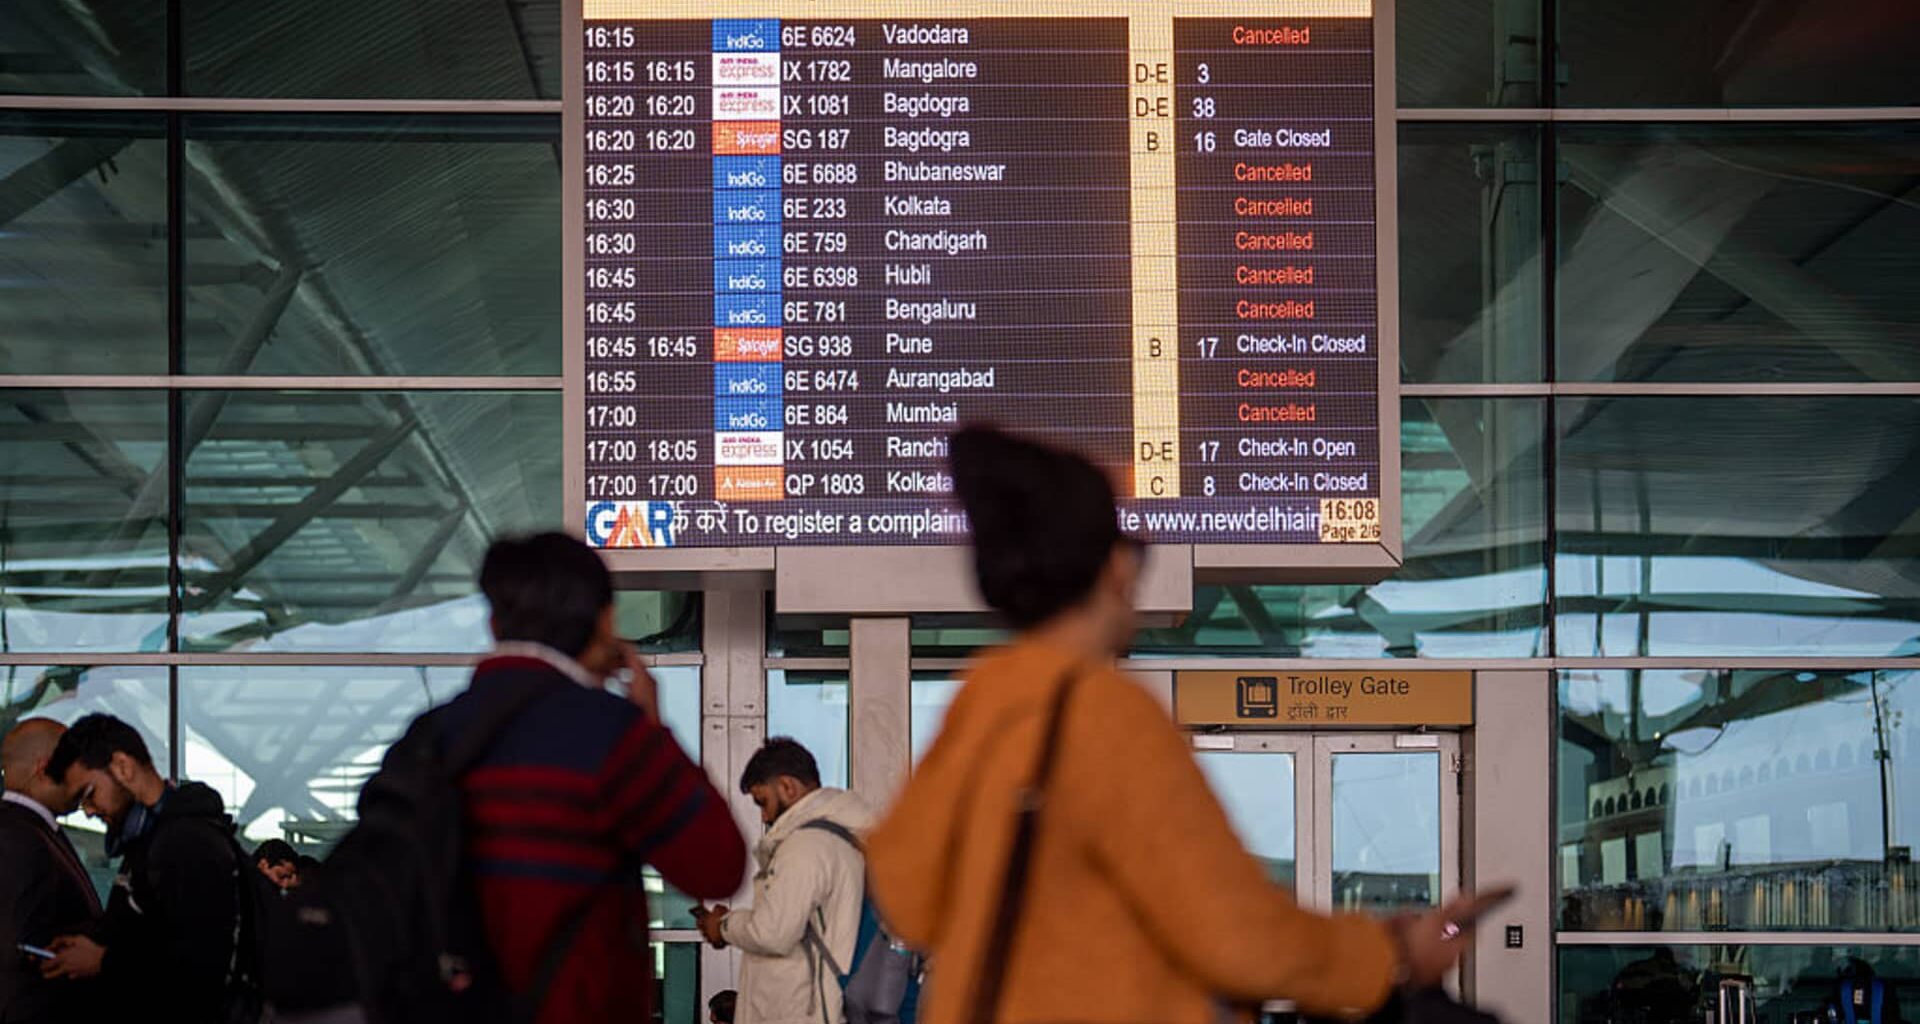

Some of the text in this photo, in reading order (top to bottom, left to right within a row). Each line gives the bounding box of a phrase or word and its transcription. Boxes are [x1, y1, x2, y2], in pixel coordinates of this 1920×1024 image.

[586, 27, 634, 47] 16:15
[782, 27, 806, 46] 6E
[812, 26, 855, 46] 6624
[883, 24, 968, 44] Vadodara
[1232, 26, 1309, 44] Cancelled
[586, 62, 634, 81] 16:15
[647, 61, 694, 81] 16:15
[784, 61, 801, 81] IX
[808, 61, 850, 81] 1782
[884, 58, 976, 83] Mangalore
[1136, 64, 1168, 83] D-E
[1198, 64, 1209, 83] 3
[586, 96, 634, 116] 16:20
[647, 96, 694, 116] 16:20
[784, 95, 801, 115] IX
[808, 95, 848, 115] 1081
[884, 93, 969, 117] Bagdogra
[1136, 98, 1168, 117] D-E
[1193, 98, 1215, 117] 38
[587, 130, 634, 150] 16:20
[647, 130, 694, 150] 16:20
[784, 129, 811, 149] SG
[818, 129, 850, 149] 187
[885, 127, 969, 152] Bagdogra
[1147, 132, 1159, 151] B
[1194, 132, 1215, 152] 16
[1234, 129, 1271, 146] Gate
[1276, 129, 1330, 146] Closed
[587, 165, 634, 185] 16:25
[784, 164, 807, 183] 6E
[813, 164, 857, 183] 6688
[885, 161, 1005, 181] Bhubaneswar
[1235, 162, 1311, 181] Cancelled
[587, 199, 634, 220] 16:30
[784, 199, 808, 218] 6E
[813, 198, 846, 218] 233
[885, 196, 951, 215] Kolkata
[1235, 197, 1312, 215] Cancelled
[587, 233, 635, 254] 16:30
[784, 233, 808, 252] 6E
[814, 233, 846, 252] 759
[885, 230, 986, 255] Chandigarh
[1235, 232, 1313, 250] Cancelled
[587, 268, 635, 288] 16:45
[784, 267, 808, 287] 6E
[814, 267, 857, 287] 6398
[886, 264, 930, 284] Hubli
[1236, 266, 1313, 284] Cancelled
[587, 302, 635, 323] 16:45
[784, 302, 808, 322] 6E
[814, 302, 845, 322] 781
[886, 299, 975, 324] Bengaluru
[1237, 300, 1314, 318] Cancelled
[587, 336, 635, 357] 16:45
[649, 336, 696, 357] 16:45
[785, 336, 813, 356] SG
[819, 336, 852, 356] 938
[887, 333, 932, 353] Pune
[1150, 338, 1161, 357] B
[1198, 338, 1218, 358] 17
[1237, 335, 1306, 353] Check-In
[1312, 335, 1365, 353] Closed
[588, 371, 636, 391] 16:55
[785, 371, 809, 390] 6E
[815, 370, 858, 390] 6474
[886, 368, 994, 392] Aurangabad
[1237, 369, 1315, 387] Cancelled
[588, 406, 636, 426] 17:00
[785, 405, 810, 424] 6E
[815, 405, 848, 424] 864
[887, 402, 957, 422] Mumbai
[1238, 403, 1315, 421] Cancelled
[588, 440, 636, 461] 17:00
[649, 440, 696, 461] 18:05
[786, 440, 804, 460] IX
[812, 440, 853, 460] 1054
[887, 437, 948, 457] Ranchi
[1141, 442, 1172, 461] D-E
[1200, 442, 1219, 461] 17
[1239, 438, 1307, 456] Check-In
[1313, 438, 1355, 460] Open
[588, 475, 636, 496] 17:00
[649, 475, 697, 495] 17:00
[786, 474, 814, 496] QP
[821, 474, 864, 494] 1803
[888, 471, 953, 492] Kolkata
[1151, 476, 1164, 496] C
[1204, 476, 1215, 496] 8
[1239, 473, 1308, 491] Check-In
[1314, 473, 1367, 491] Closed
[1325, 500, 1375, 520] 16:08
[588, 500, 674, 547] GMR
[733, 510, 759, 533] To
[766, 509, 844, 539] register
[849, 515, 862, 533] a
[868, 508, 968, 539] complaint
[1116, 507, 1140, 531] te
[1322, 524, 1381, 541] Page 2/6
[1288, 676, 1410, 698] Trolley Gate
